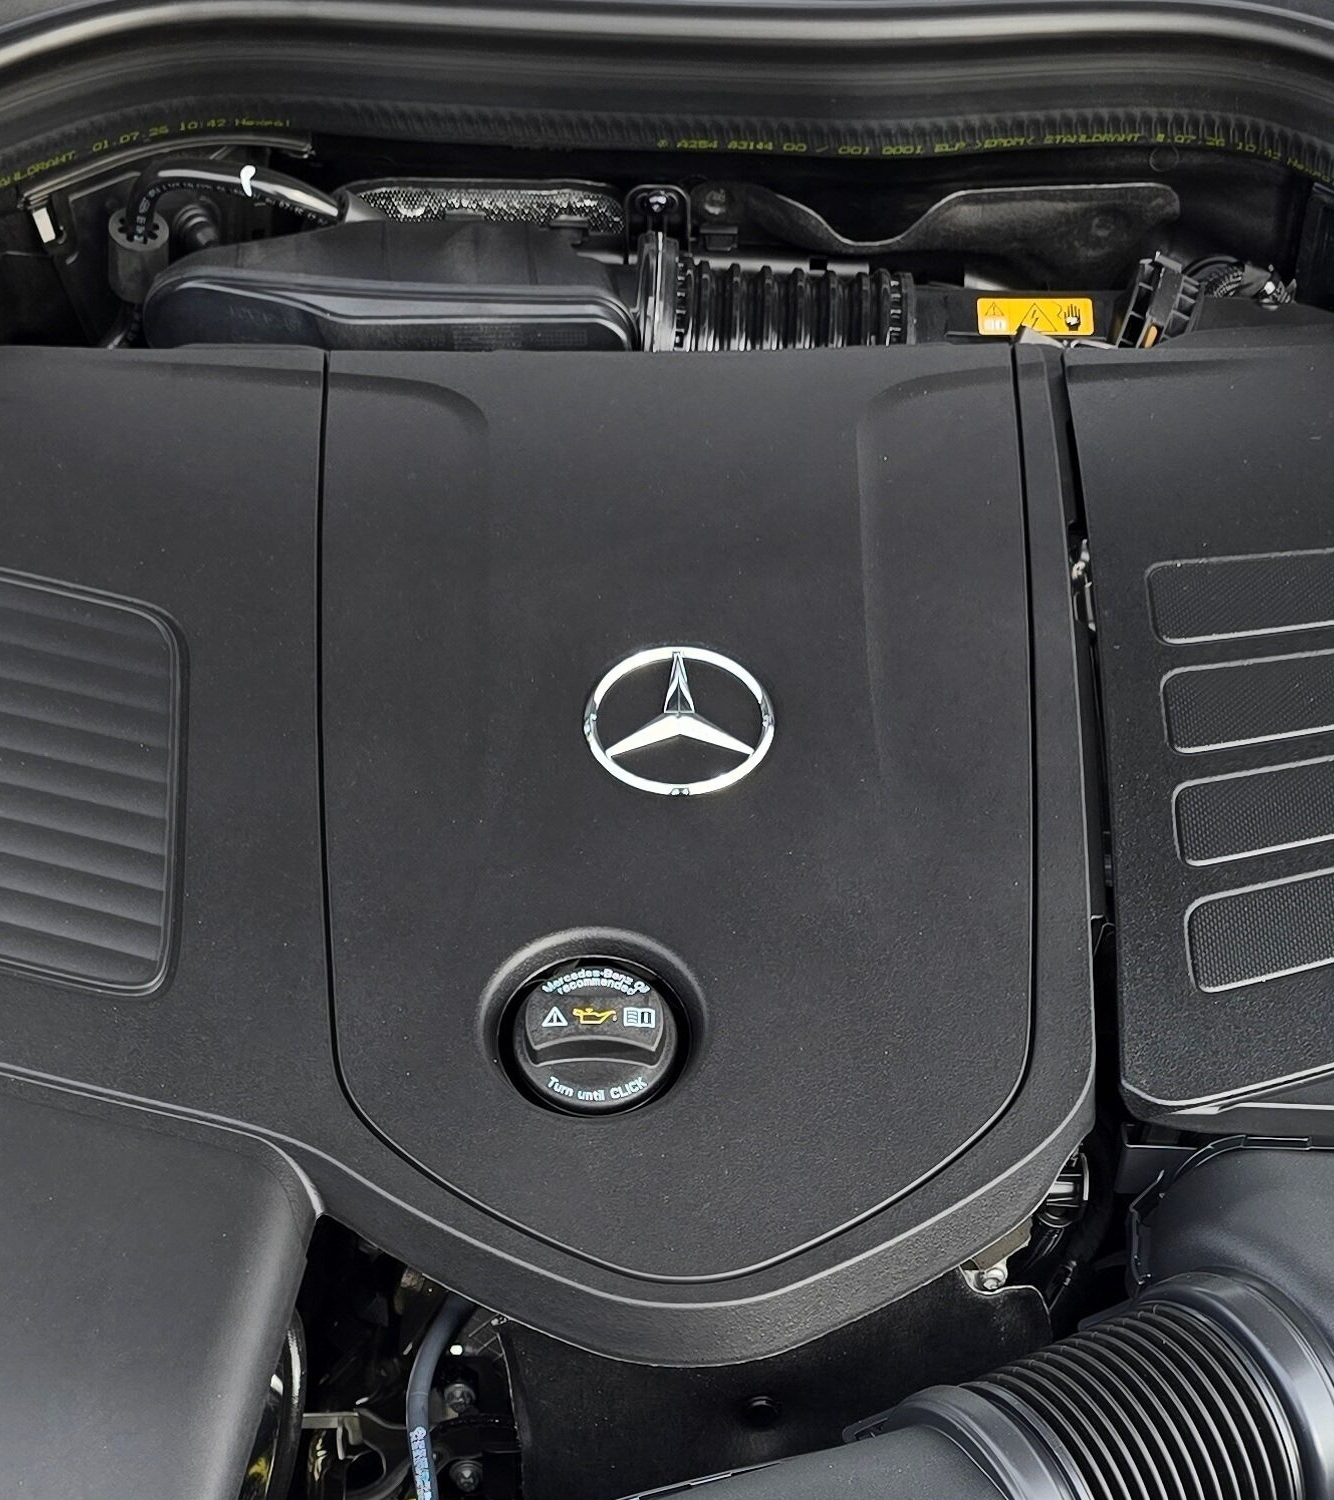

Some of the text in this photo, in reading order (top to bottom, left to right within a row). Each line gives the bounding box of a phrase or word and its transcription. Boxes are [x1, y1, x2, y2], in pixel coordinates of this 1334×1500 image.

[541, 968, 634, 994] Mercedes-Benz
[557, 977, 637, 996] recommended
[547, 1077, 648, 1102] Turn until CLICK
